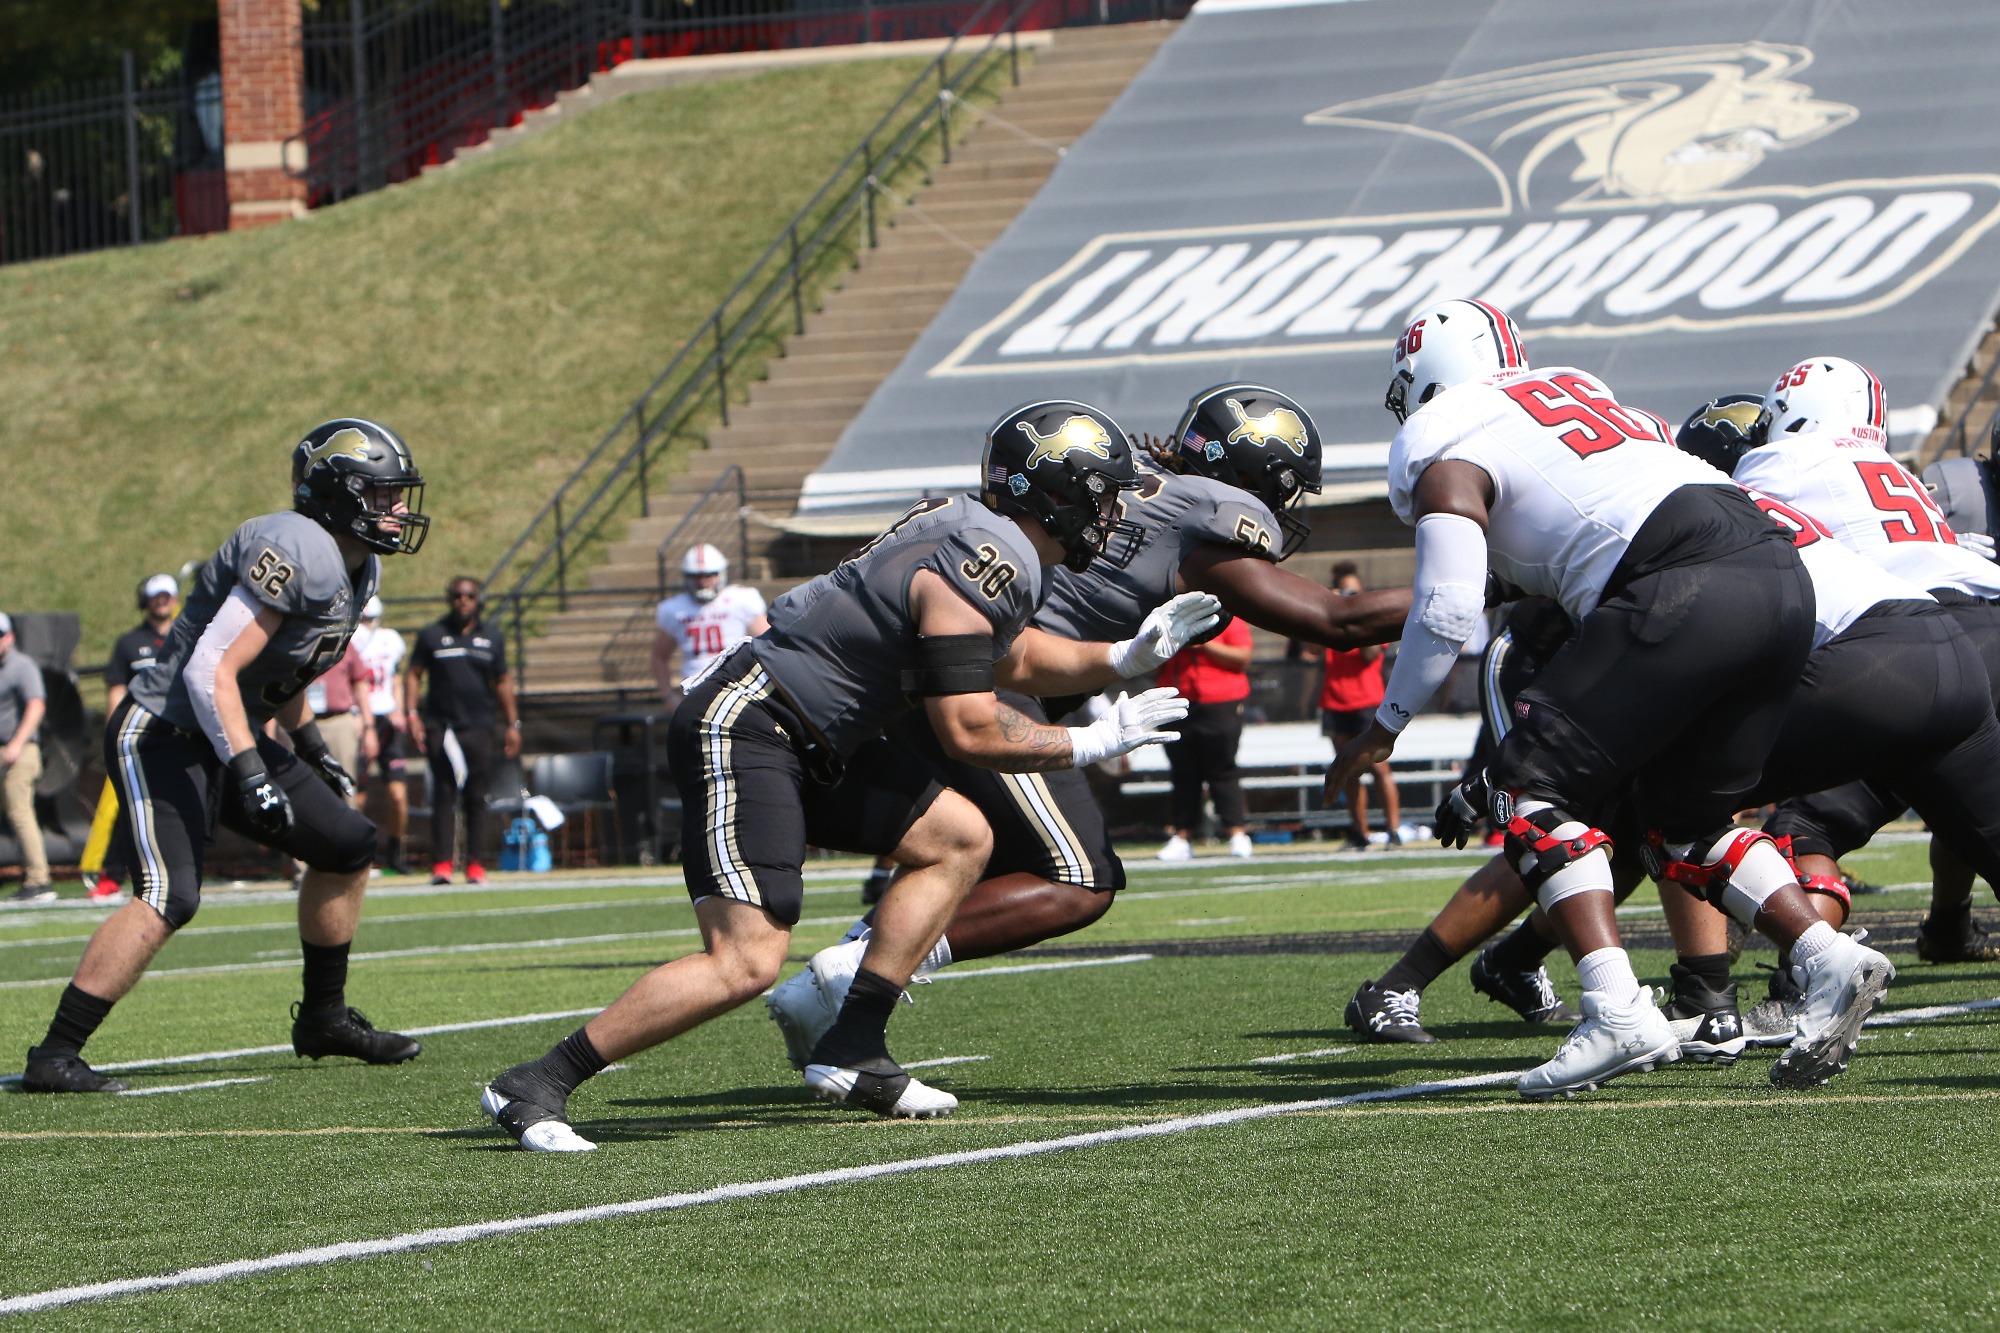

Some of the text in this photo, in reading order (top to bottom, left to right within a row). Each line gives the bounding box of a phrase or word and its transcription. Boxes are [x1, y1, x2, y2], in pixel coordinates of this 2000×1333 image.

[999, 191, 1973, 355] LINDENWOOD
[1395, 319, 1427, 364] 56
[1775, 363, 1814, 392] 55
[1498, 374, 1664, 461] 56
[1233, 514, 1272, 555] 56
[249, 547, 295, 600] 52
[960, 543, 1018, 601] 30
[685, 624, 723, 657] 70
